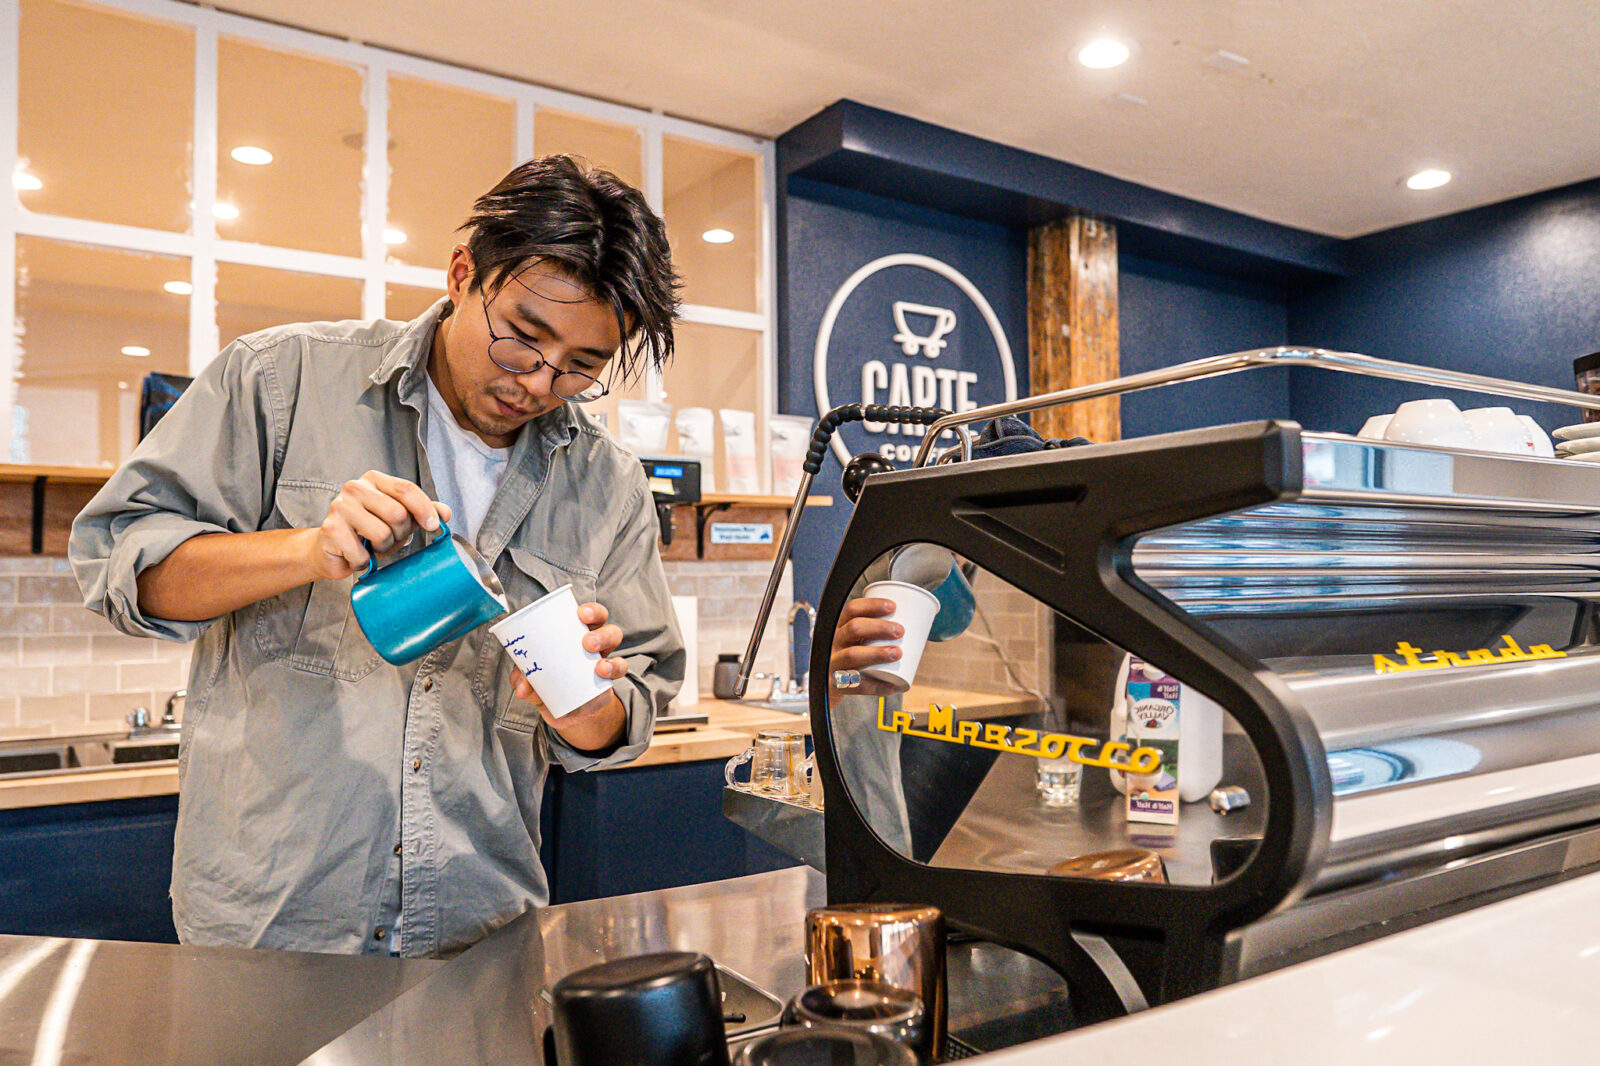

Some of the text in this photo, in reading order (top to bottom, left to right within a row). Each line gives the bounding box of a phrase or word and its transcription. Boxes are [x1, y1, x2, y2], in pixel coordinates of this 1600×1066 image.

[861, 360, 978, 439] CARTE
[1372, 634, 1568, 675] strada
[928, 703, 1164, 773] MARZOCCO
